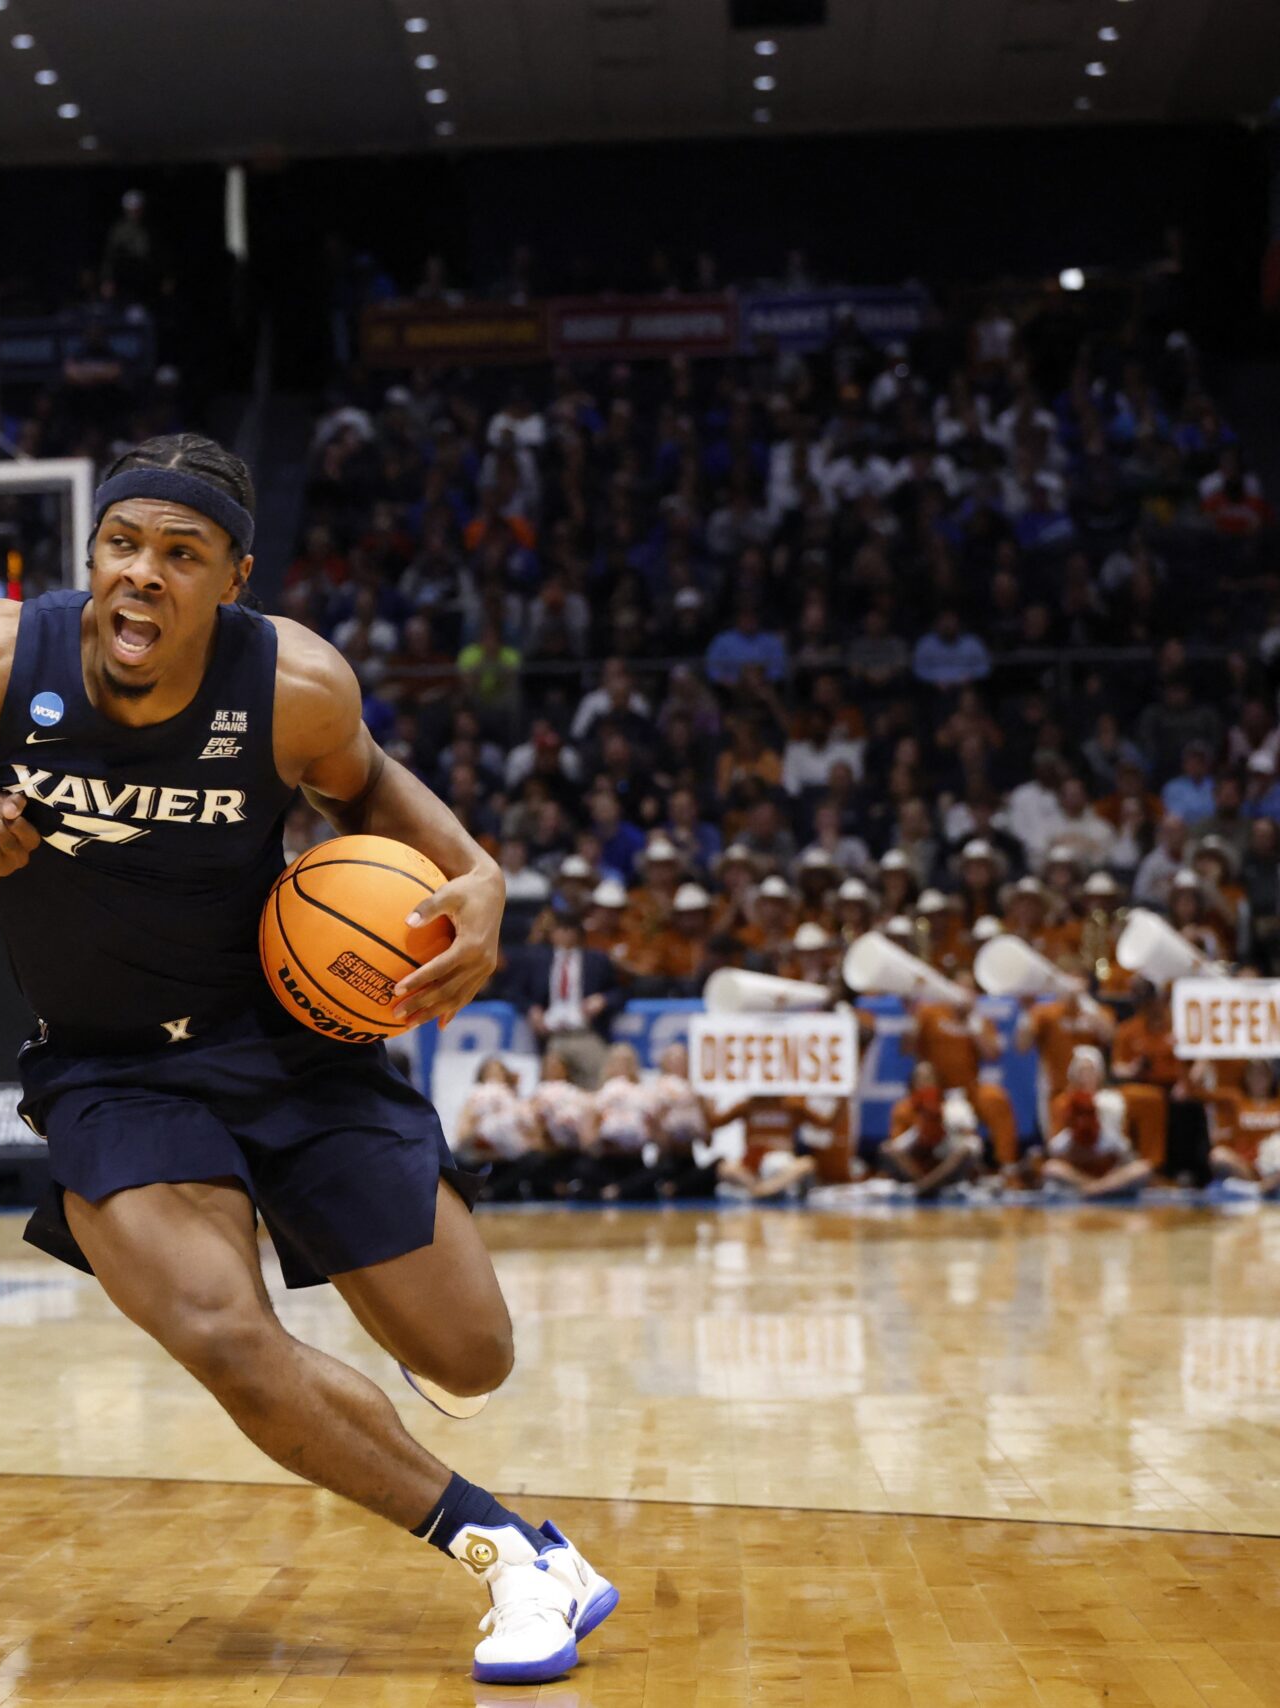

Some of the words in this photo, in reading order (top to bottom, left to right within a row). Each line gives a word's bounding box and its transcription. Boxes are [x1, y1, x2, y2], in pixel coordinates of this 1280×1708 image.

[33, 704, 60, 721] NCAA
[215, 711, 230, 721] BE
[231, 711, 247, 722] THE
[211, 720, 248, 732] CHANGE
[201, 746, 243, 755] EAST
[207, 737, 237, 747] BIG
[3, 764, 248, 824] XAVIER
[339, 953, 385, 990] MADNESS
[346, 974, 381, 1001] MARCH
[278, 963, 388, 1042] Wilson
[701, 1034, 841, 1083] DEFENSE
